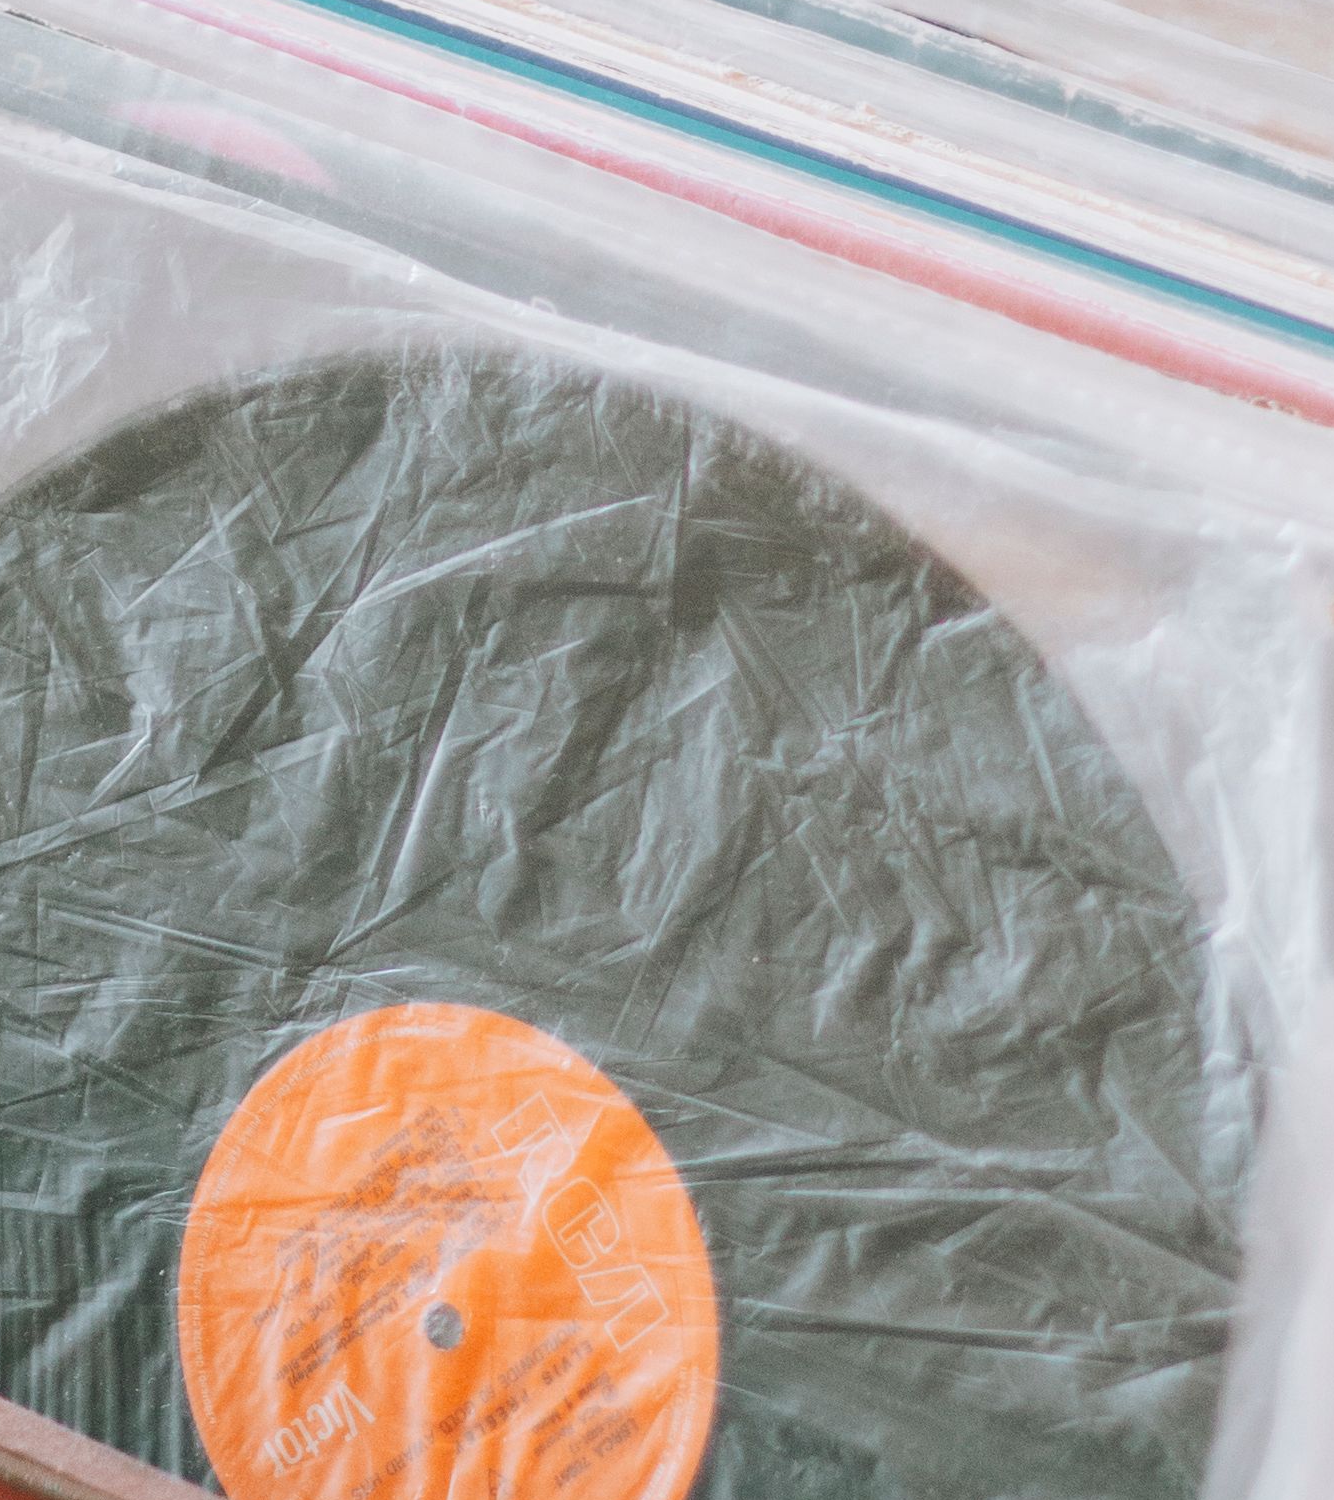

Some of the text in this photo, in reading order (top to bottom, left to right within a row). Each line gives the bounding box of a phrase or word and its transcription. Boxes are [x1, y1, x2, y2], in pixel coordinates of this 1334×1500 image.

[491, 1090, 669, 1352] RCA
[539, 1337, 594, 1387] ELVIS
[261, 1381, 375, 1478] Victor
